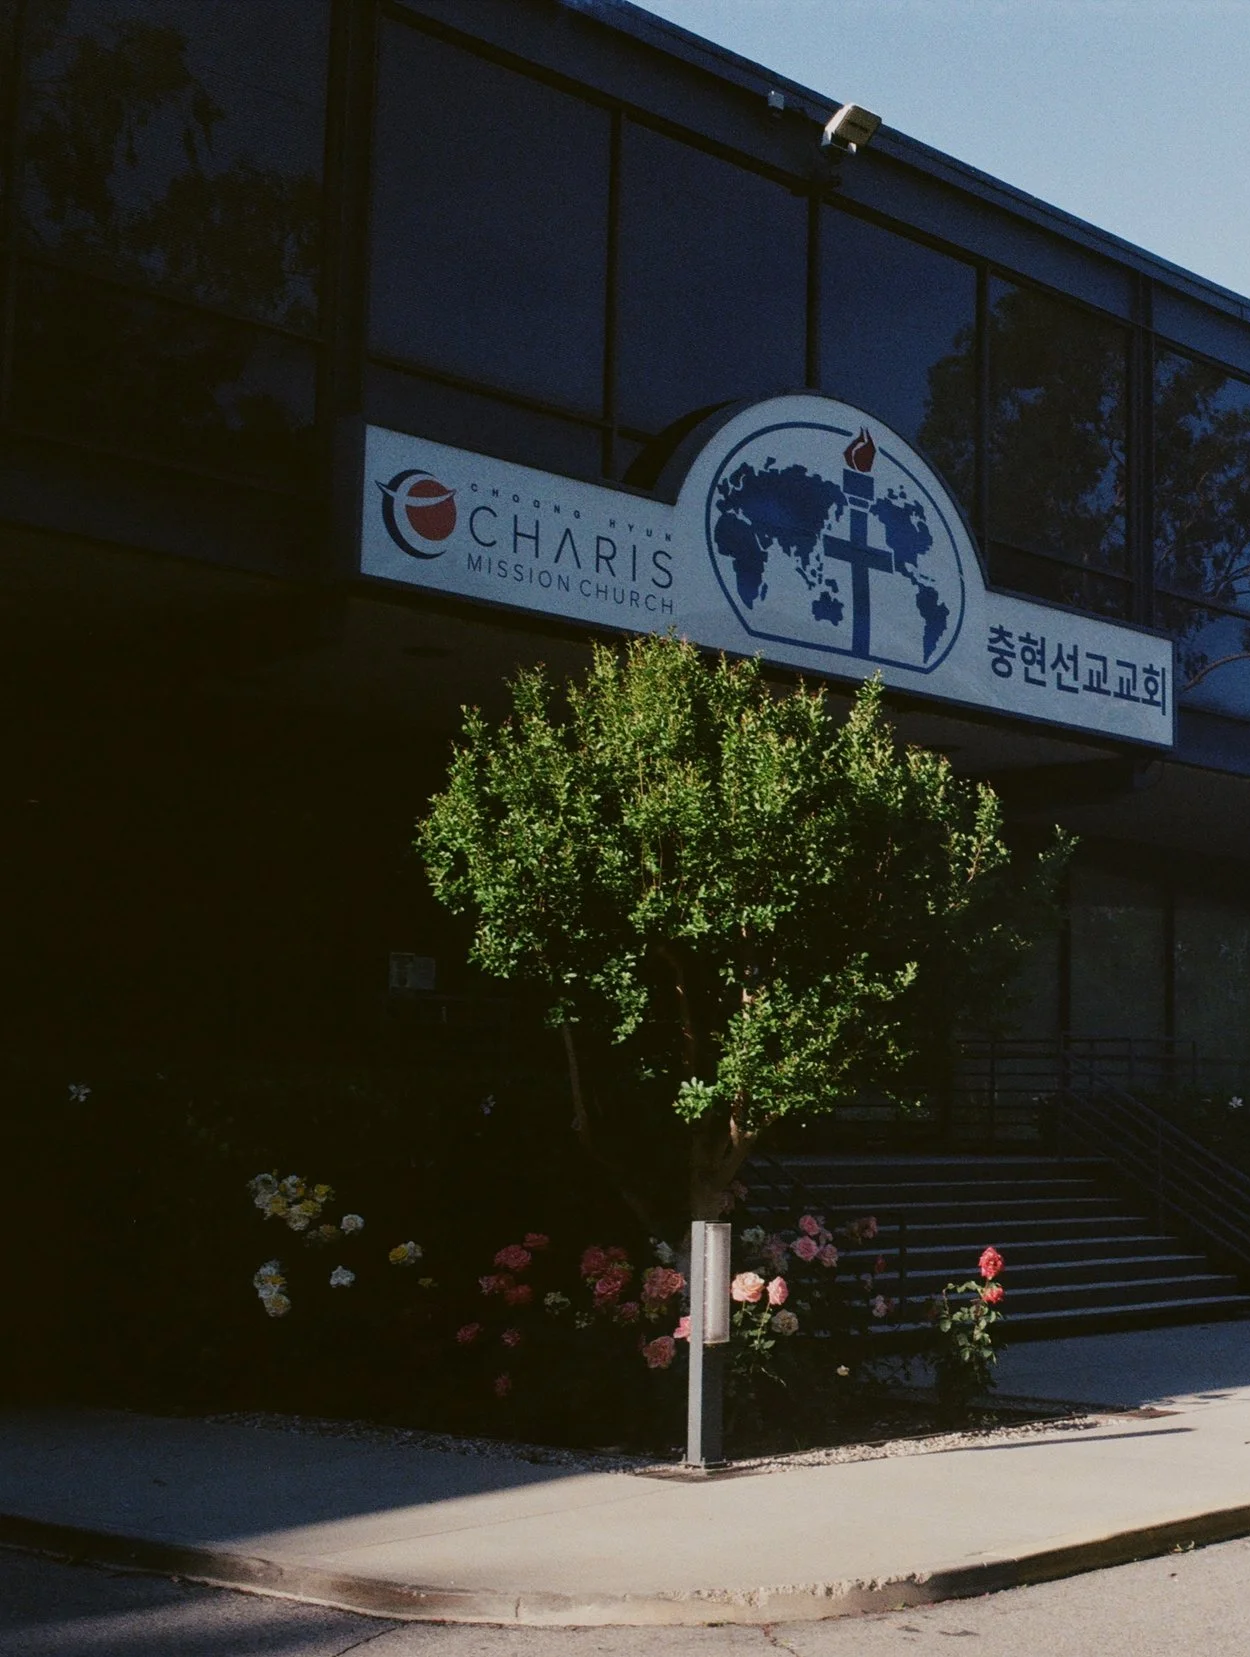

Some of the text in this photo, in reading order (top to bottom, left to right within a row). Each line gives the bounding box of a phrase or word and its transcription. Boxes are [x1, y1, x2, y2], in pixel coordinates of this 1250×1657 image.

[469, 505, 673, 589] CHARIS
[471, 483, 672, 542] CHOONG HYUN
[467, 553, 673, 615] MISSION CHURCH
[987, 624, 1167, 716] 충현선교교회
